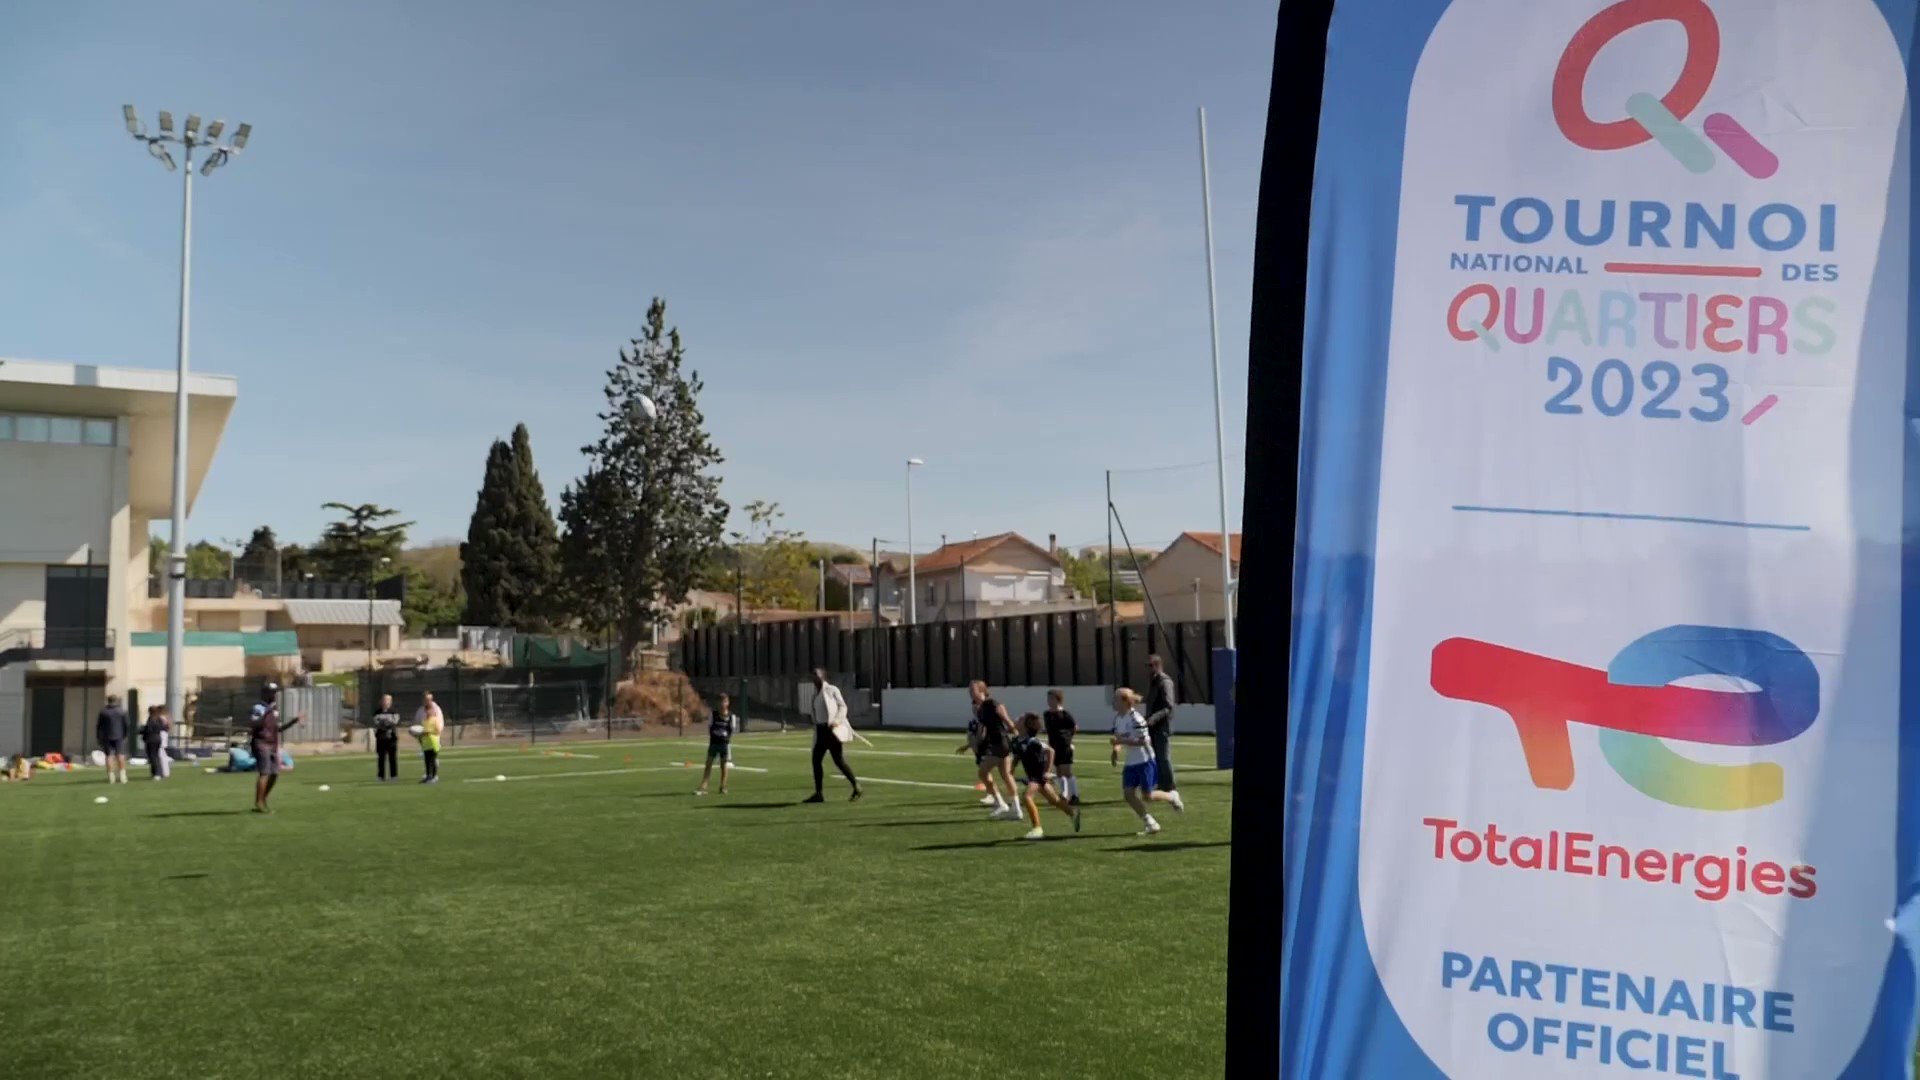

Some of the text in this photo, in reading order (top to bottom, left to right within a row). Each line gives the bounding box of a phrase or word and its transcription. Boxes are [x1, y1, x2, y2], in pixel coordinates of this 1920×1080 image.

[1454, 195, 1837, 252] TOURNOI
[1450, 252, 1839, 282] NATIONAL DES
[1447, 283, 1838, 355] QUARTIERS
[1544, 357, 1730, 422] 2023
[1423, 817, 1817, 901] TotalEnergies
[1441, 951, 1795, 1033] PARTENAIRE
[1487, 1012, 1740, 1080] OFFICIEL
